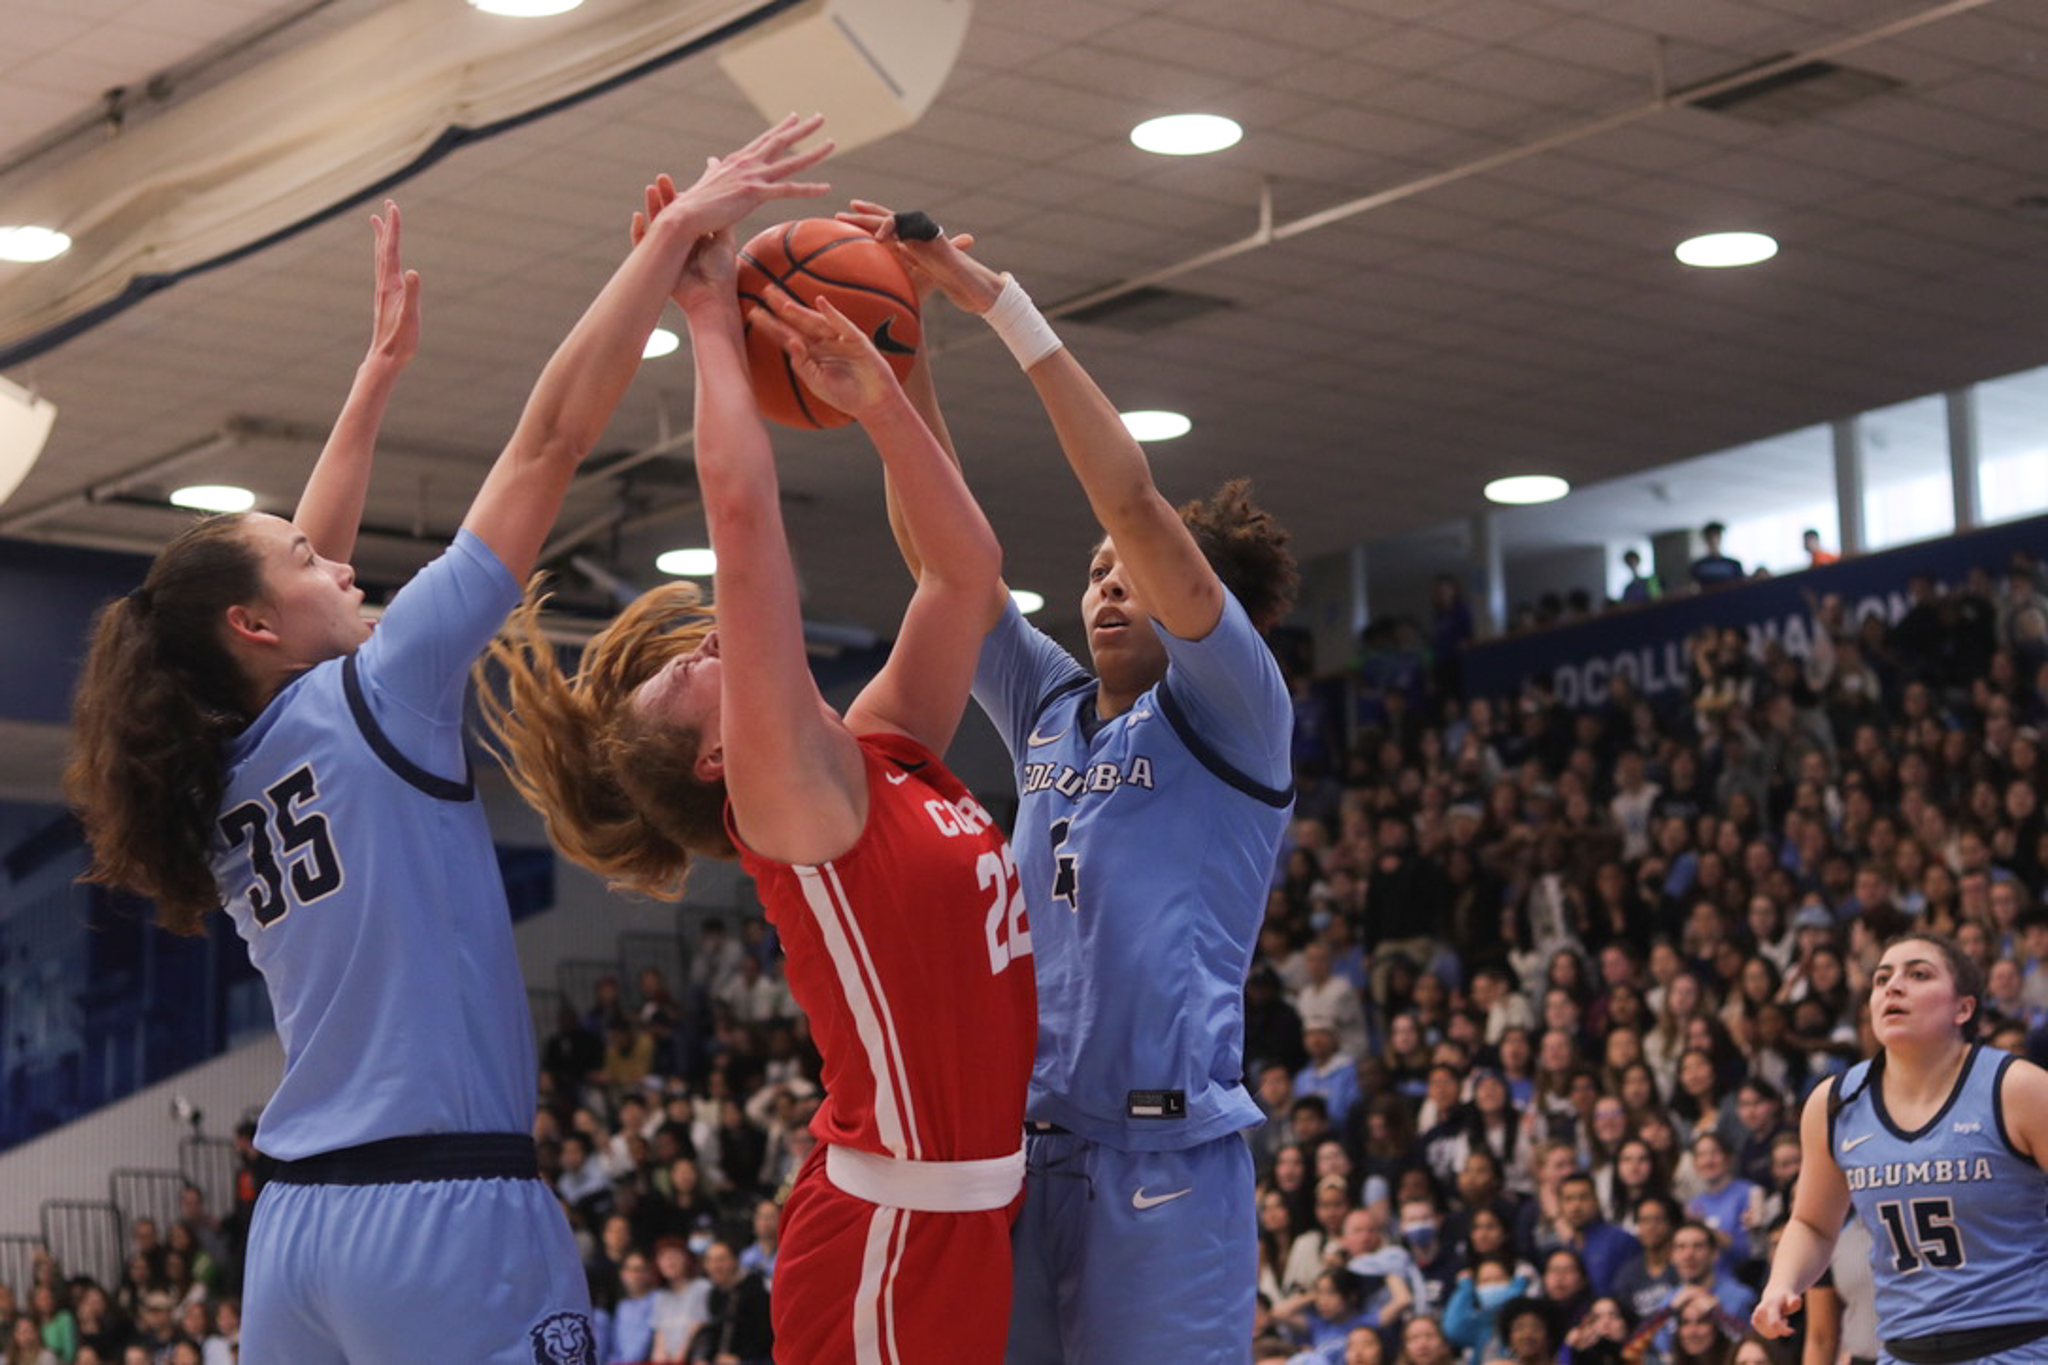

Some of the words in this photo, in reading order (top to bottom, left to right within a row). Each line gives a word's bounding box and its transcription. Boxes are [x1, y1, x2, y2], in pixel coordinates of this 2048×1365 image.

[217, 761, 343, 930] 35
[976, 842, 1034, 975] 22
[1170, 1098, 1179, 1110] L
[1876, 1196, 1966, 1275] 15
